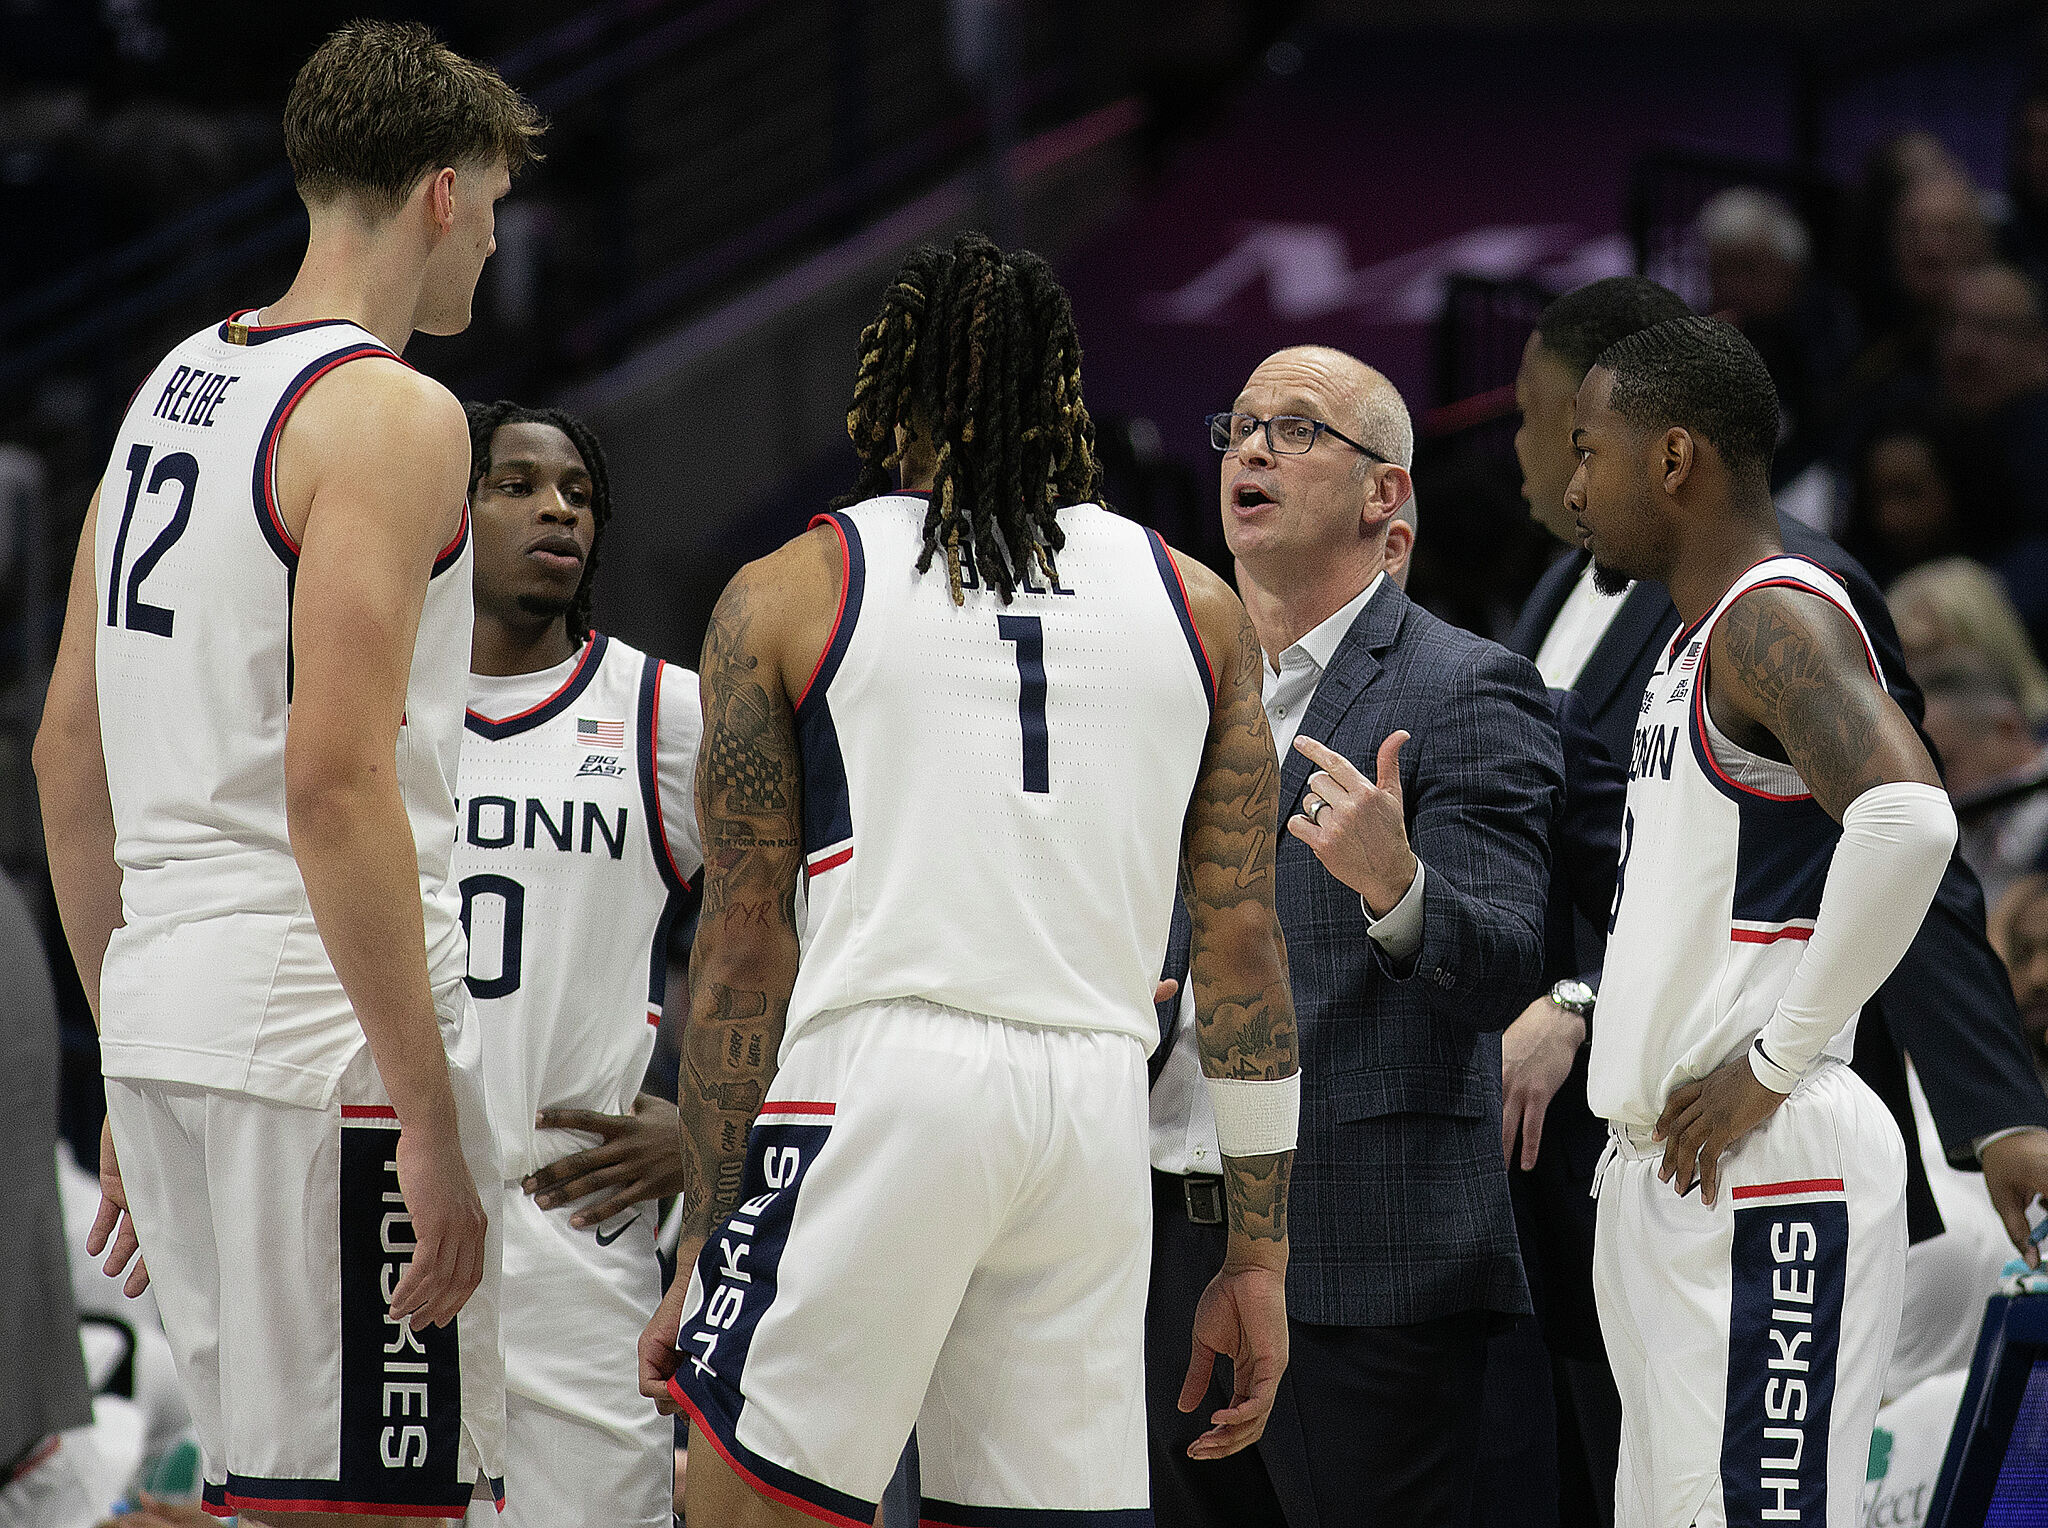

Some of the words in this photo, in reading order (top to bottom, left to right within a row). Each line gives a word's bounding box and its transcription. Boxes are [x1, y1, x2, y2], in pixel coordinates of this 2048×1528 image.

[153, 365, 240, 427] REIBE
[107, 443, 200, 638] 12
[947, 540, 1075, 596] BLL
[997, 615, 1049, 793] 1
[579, 764, 627, 775] EAST
[585, 755, 618, 764] BIG
[454, 795, 629, 861] ONN
[459, 873, 525, 999] 0
[1760, 1221, 1818, 1521] HUSKIES
